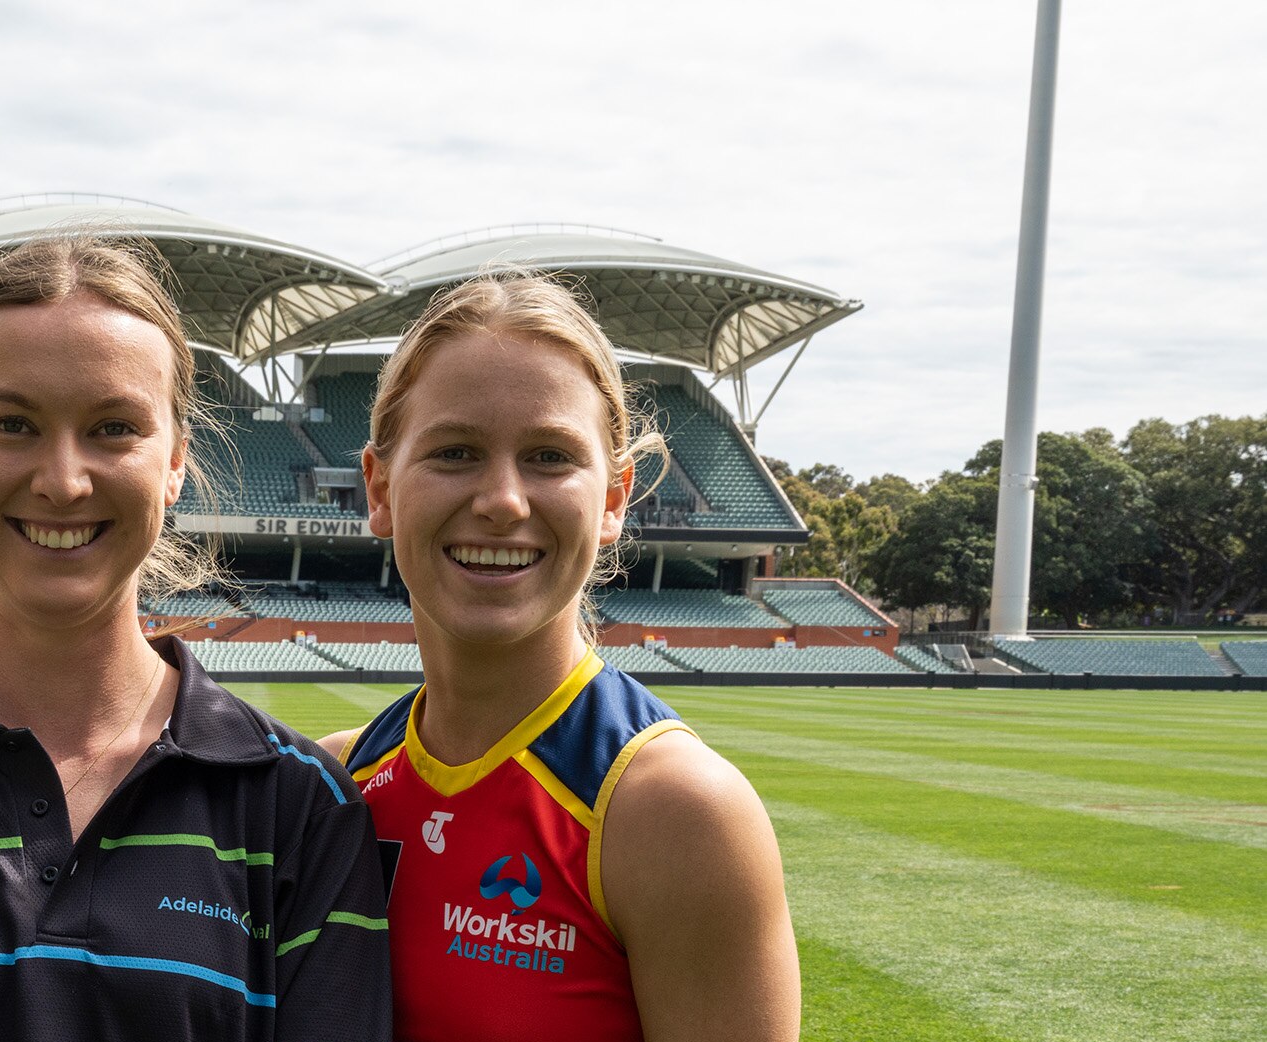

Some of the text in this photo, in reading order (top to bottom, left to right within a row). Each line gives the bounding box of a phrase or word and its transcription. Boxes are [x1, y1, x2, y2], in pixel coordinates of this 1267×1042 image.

[256, 519, 362, 535] SIR EDWIN
[158, 896, 239, 925] Adelaide
[443, 903, 576, 951] Workskil
[446, 935, 564, 974] Australia
